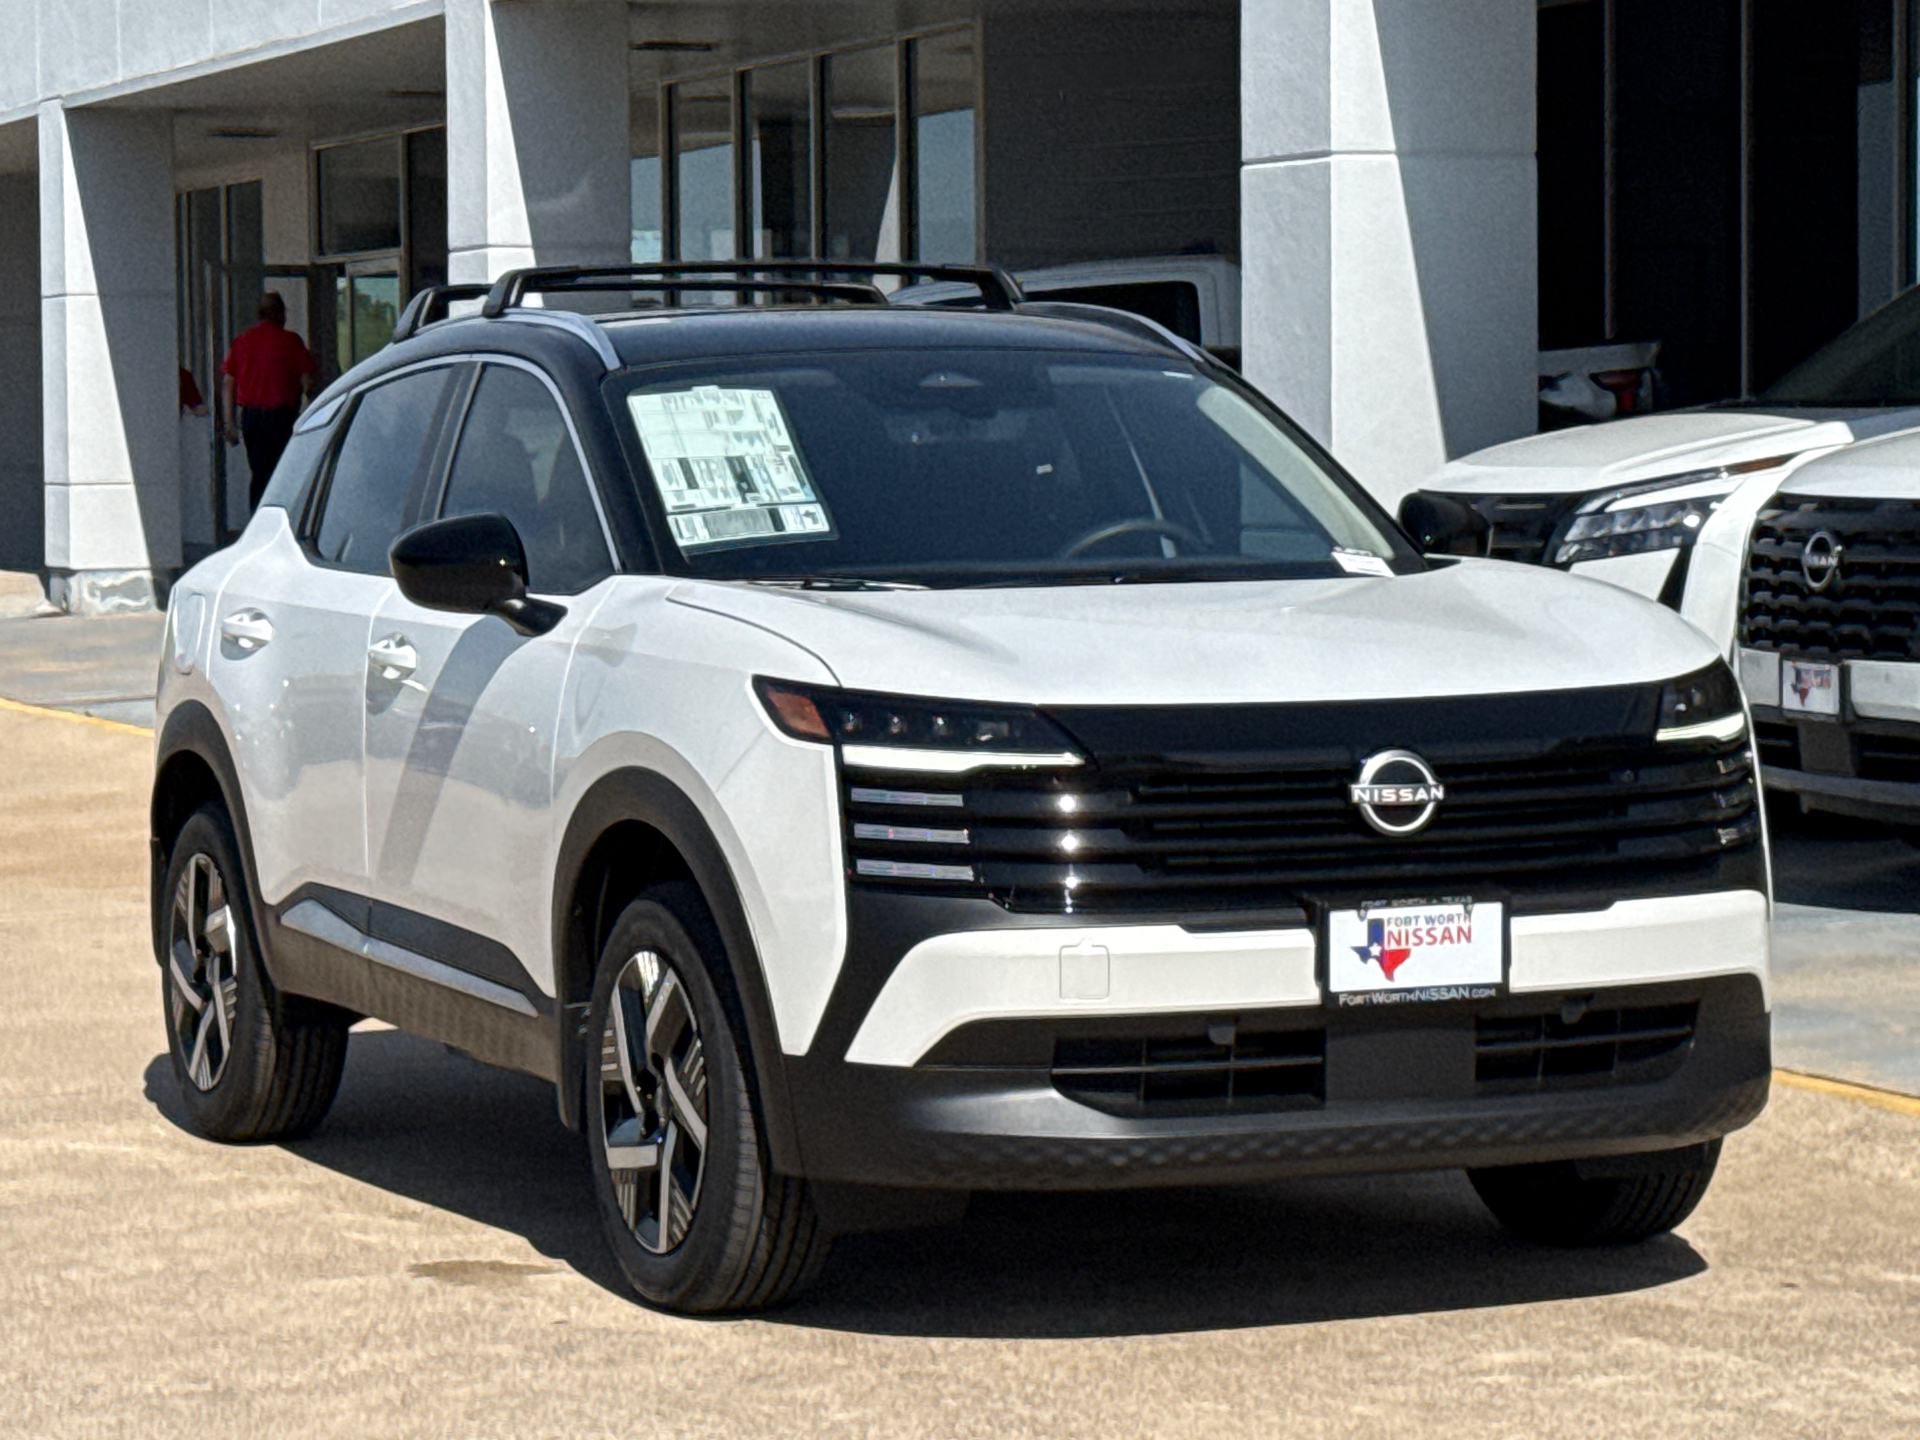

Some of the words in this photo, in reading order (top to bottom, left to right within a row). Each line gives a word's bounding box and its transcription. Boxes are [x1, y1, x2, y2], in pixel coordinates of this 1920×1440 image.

[1353, 786, 1444, 802] NISSAN
[1386, 915, 1421, 927] FORT
[1424, 913, 1472, 925] WORTH
[1387, 925, 1472, 948] NISSAN
